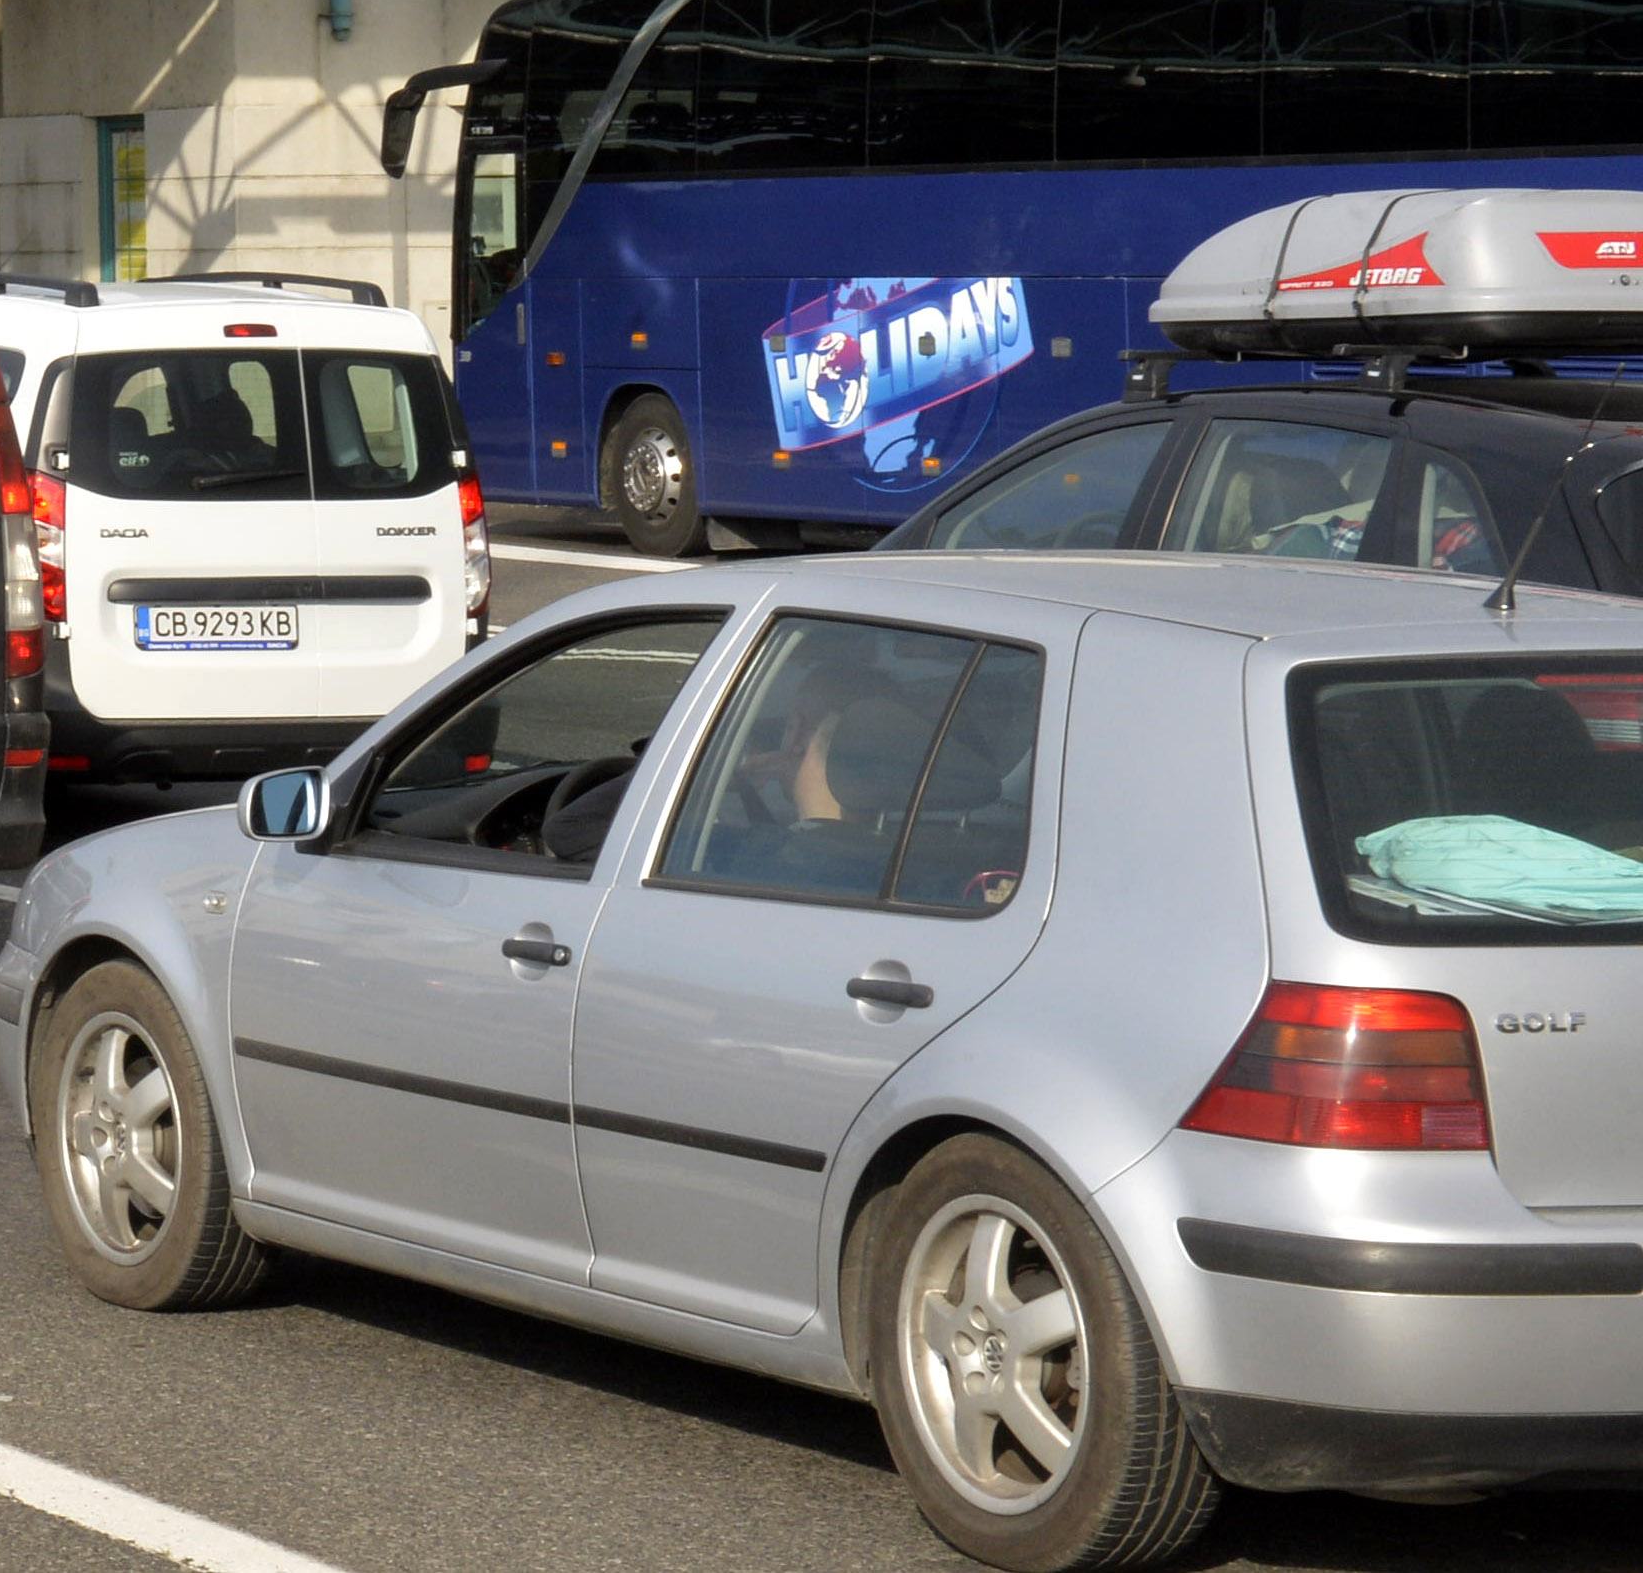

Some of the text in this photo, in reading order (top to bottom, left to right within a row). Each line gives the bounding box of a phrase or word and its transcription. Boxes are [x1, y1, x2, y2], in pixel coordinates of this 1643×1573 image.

[1349, 268, 1423, 286] JETBAG
[775, 277, 1019, 432] HOLIDAYS
[100, 529, 148, 538] DACIA
[377, 527, 436, 537] DOKKER
[155, 611, 291, 636] CB 9293 KB
[1495, 1012, 1586, 1034] GOLF
